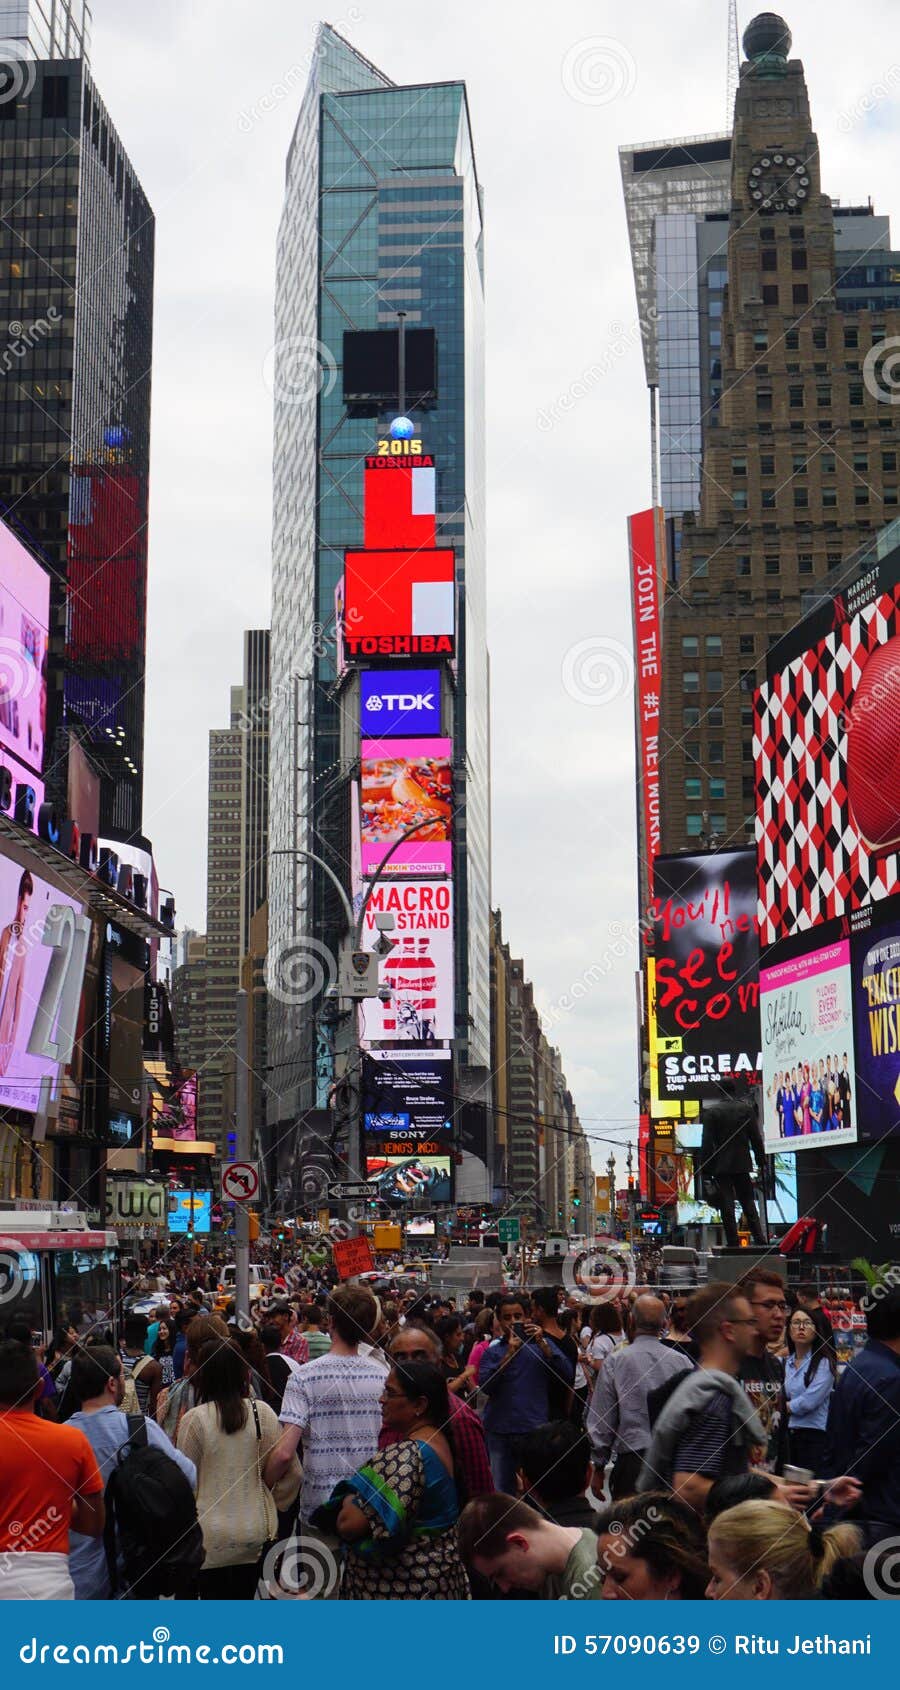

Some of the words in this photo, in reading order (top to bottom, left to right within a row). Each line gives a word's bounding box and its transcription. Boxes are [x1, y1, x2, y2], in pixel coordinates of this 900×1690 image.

[378, 439, 422, 455] 2015
[366, 455, 433, 468] TOSHIBA
[637, 565, 655, 622] JOIN
[848, 566, 880, 599] MARRIOTT
[848, 585, 876, 613] MARQUIS
[346, 635, 453, 656] TOSHIBA
[641, 632, 658, 678] THE
[381, 694, 435, 710] TDK
[644, 692, 659, 721] #1
[366, 886, 450, 911] MACRO
[397, 913, 449, 929] STAND
[652, 881, 731, 942] You'll
[656, 942, 738, 1007] see
[149, 987, 159, 1033] 1500
[688, 1074, 709, 1082] JUNE
[390, 1131, 426, 1139] SONY
[359, 1186, 376, 1194] WAY
